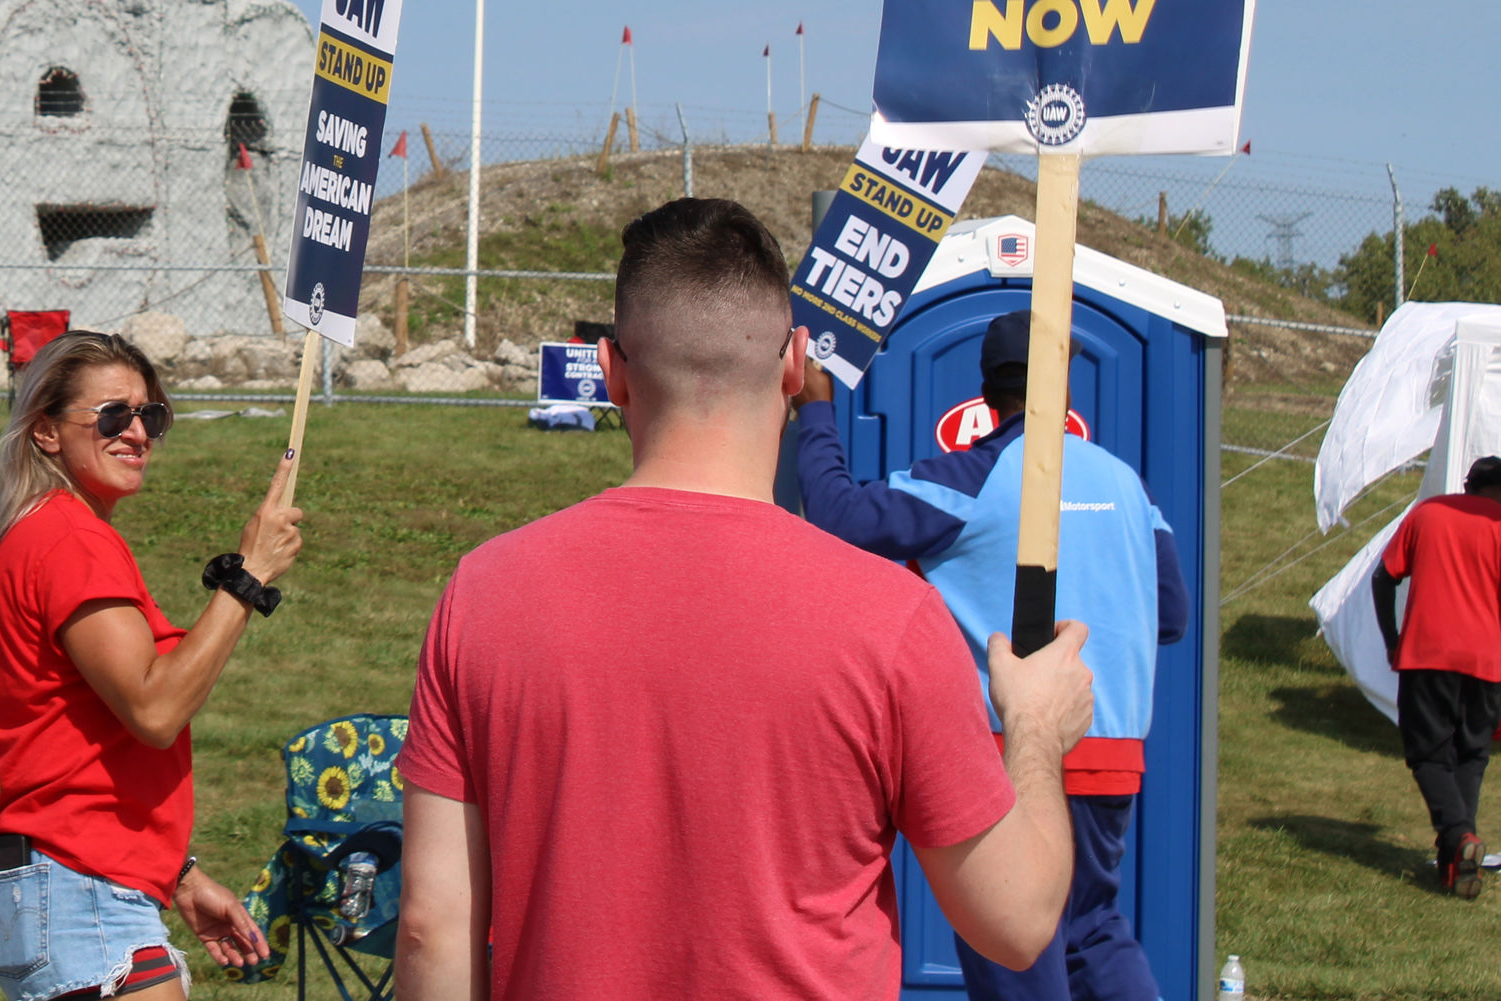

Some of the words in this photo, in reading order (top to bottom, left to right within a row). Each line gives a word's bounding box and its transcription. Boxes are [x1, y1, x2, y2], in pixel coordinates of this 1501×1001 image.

[319, 41, 363, 86] STAND
[365, 61, 386, 94] UP
[316, 110, 368, 158] SAVING
[1042, 105, 1067, 121] UAW
[300, 161, 372, 215] AMERICAN
[333, 155, 344, 168] THE
[303, 206, 354, 252] DREAM
[850, 172, 914, 218] STAND
[916, 212, 944, 233] UP
[834, 214, 910, 279] END
[805, 246, 902, 328] TIERS
